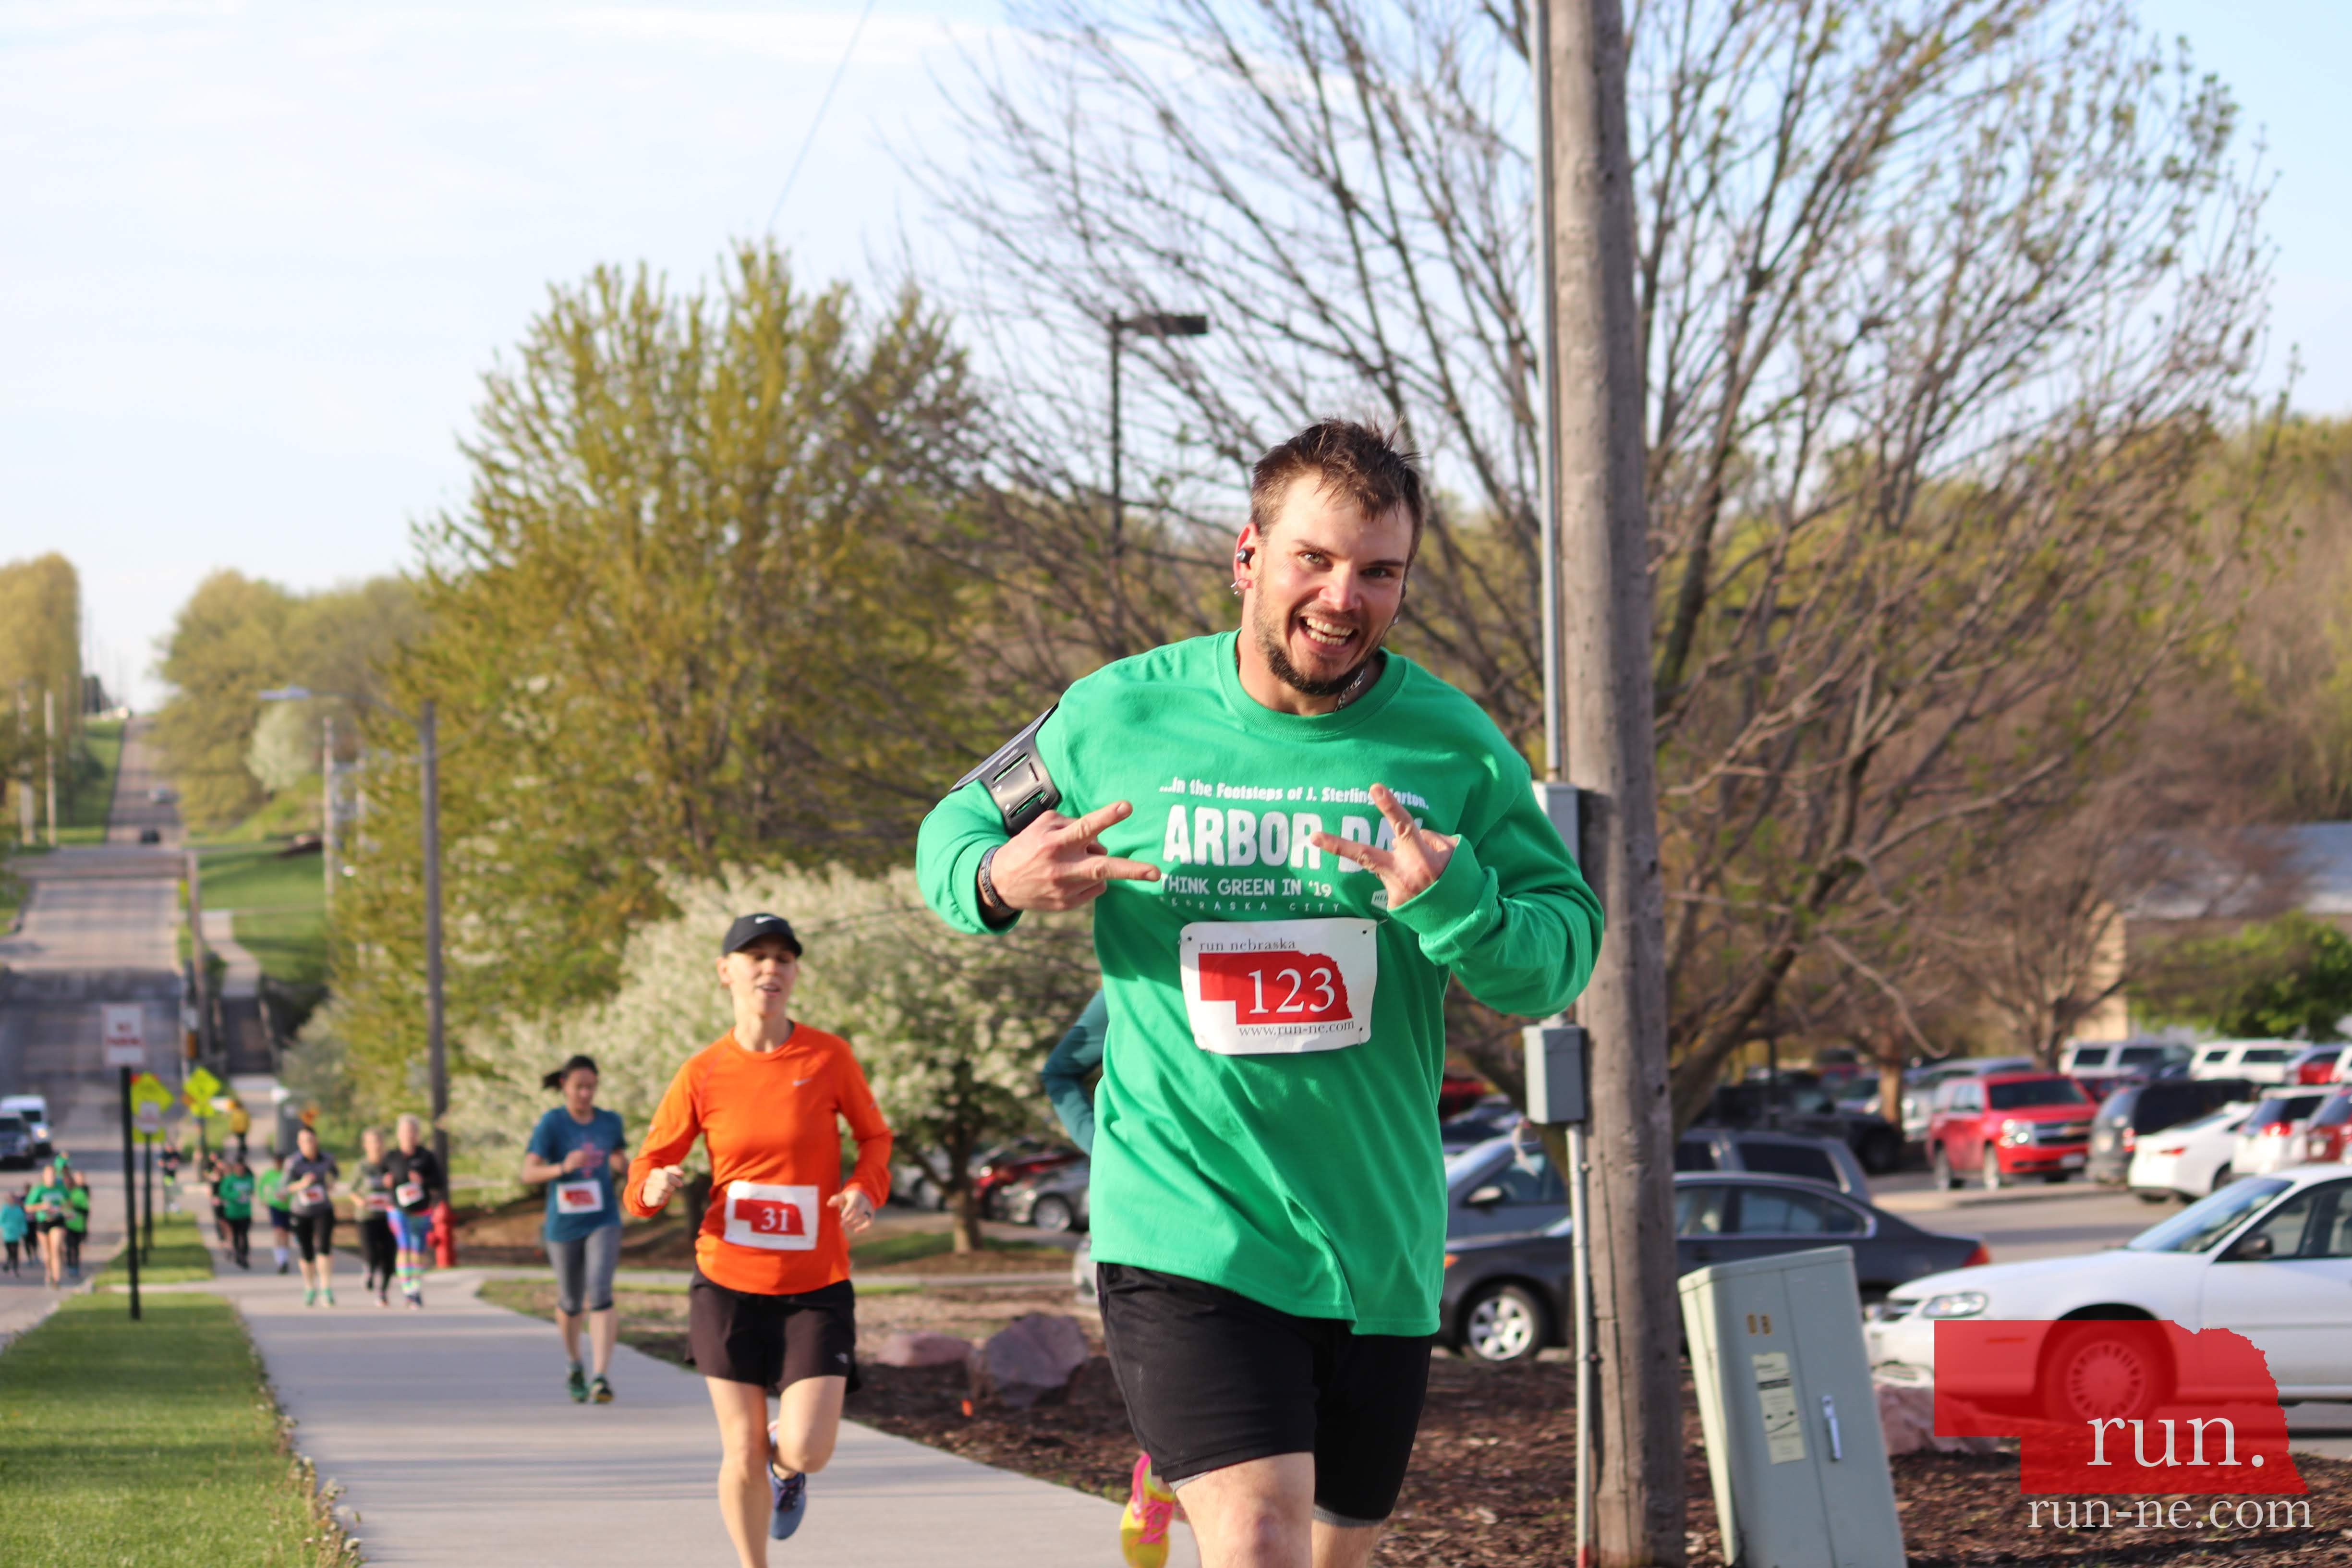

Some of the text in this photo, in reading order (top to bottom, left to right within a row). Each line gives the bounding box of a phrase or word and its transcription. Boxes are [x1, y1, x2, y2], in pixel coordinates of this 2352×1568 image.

[1189, 778, 1212, 798] the
[1216, 782, 1283, 802] Footsteps
[1287, 786, 1303, 801] of
[1306, 787, 1318, 802] J.
[1389, 788, 1429, 811] orton.
[1163, 804, 1423, 874] ARBOR DA
[1160, 873, 1210, 895] THINK
[1217, 878, 1275, 896] GREEN
[1282, 878, 1302, 896] IN
[1289, 902, 1339, 912] CITY
[1200, 937, 1296, 951] run nebraska
[1248, 967, 1335, 1014] 123
[1239, 1020, 1354, 1036] www.run-ne.com
[760, 1207, 789, 1231] 31
